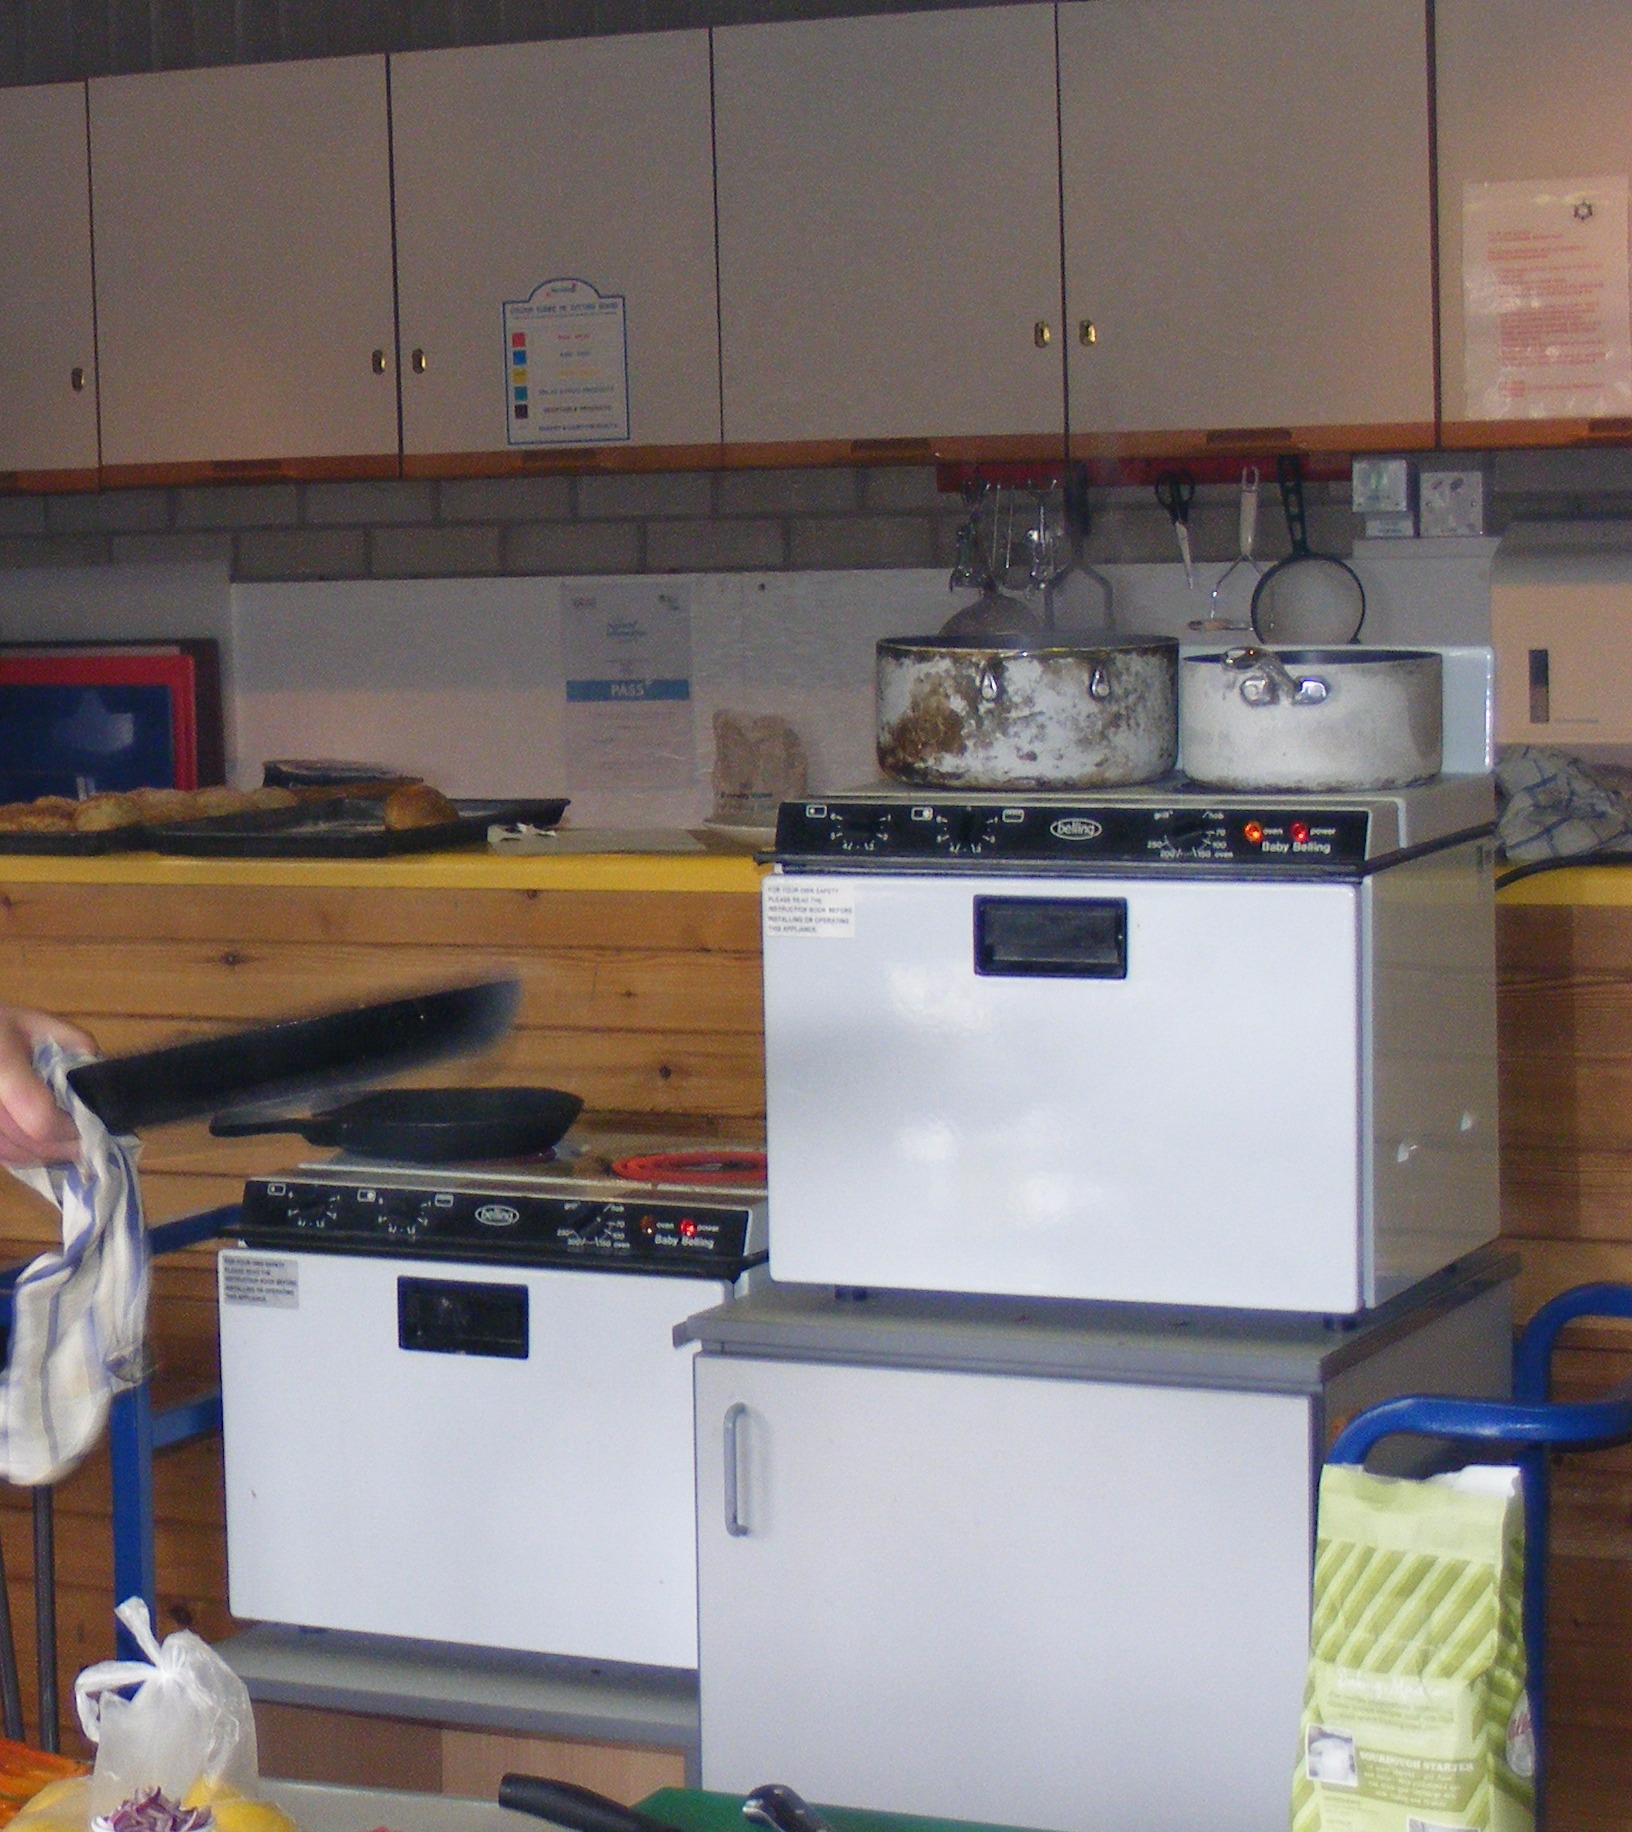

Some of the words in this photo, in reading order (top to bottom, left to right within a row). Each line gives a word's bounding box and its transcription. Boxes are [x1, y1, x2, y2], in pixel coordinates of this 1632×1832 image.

[610, 684, 645, 697] PASS
[1262, 840, 1289, 853] Baby
[1292, 841, 1331, 855] Belling
[654, 1234, 679, 1248] Baby
[681, 1235, 715, 1250] Belling
